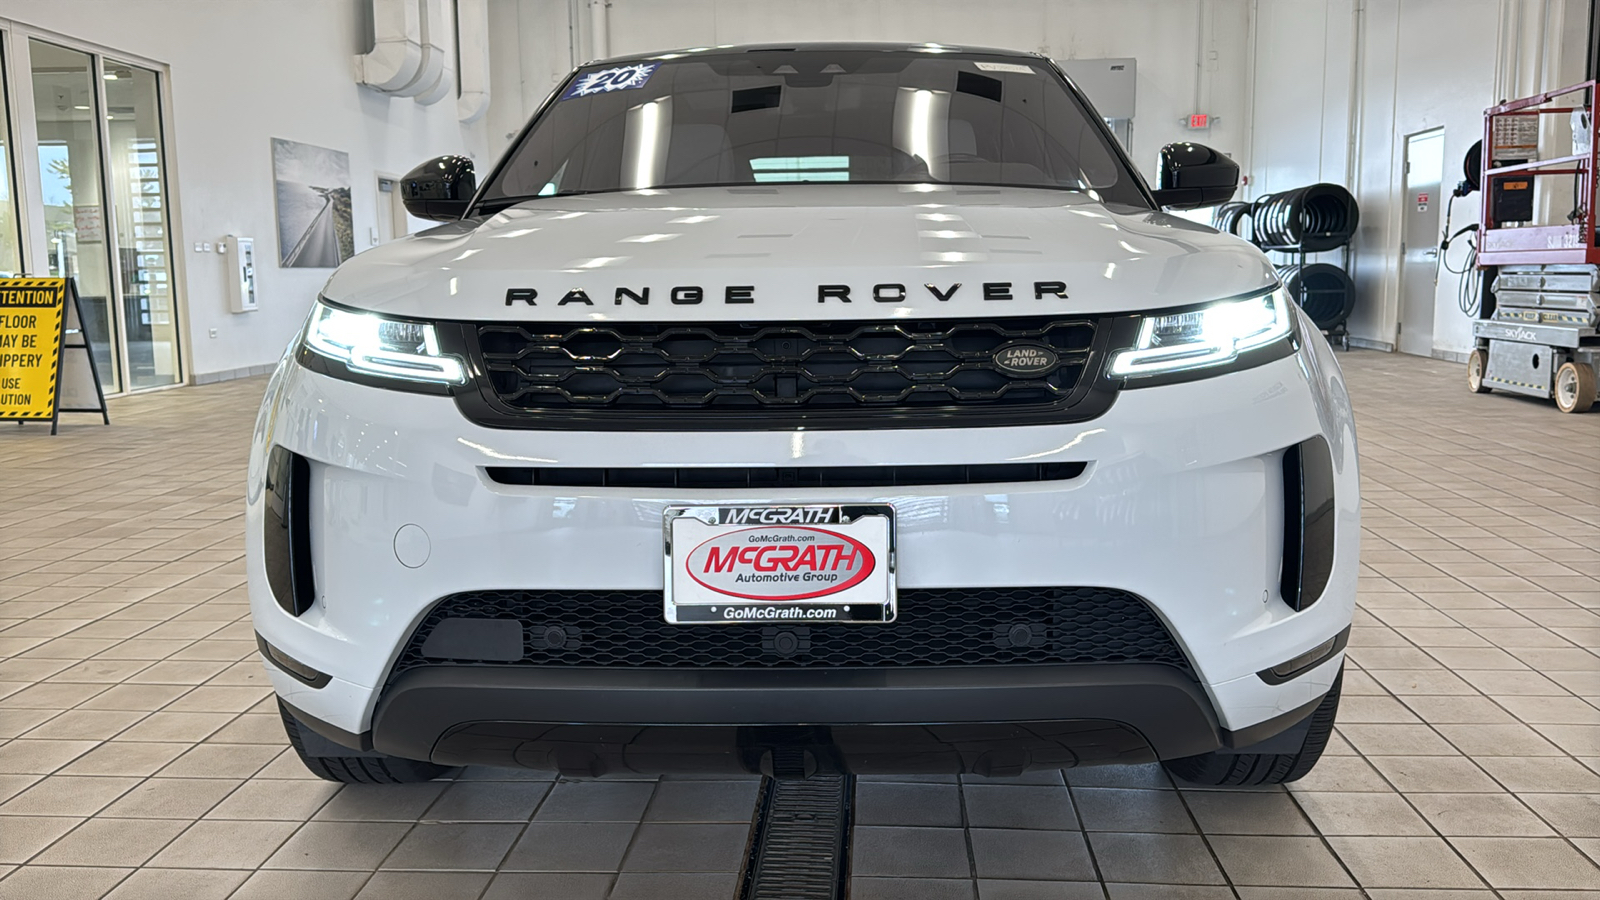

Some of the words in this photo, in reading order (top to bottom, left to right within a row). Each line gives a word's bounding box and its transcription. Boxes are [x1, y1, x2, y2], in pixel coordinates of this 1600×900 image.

[587, 69, 637, 90] 20
[0, 290, 53, 305] TENTION
[504, 285, 756, 306] RANGE
[817, 281, 1069, 303] ROVER
[0, 334, 18, 348] AY
[21, 334, 37, 348] BE
[1505, 327, 1537, 341] SKYJACK
[1010, 357, 1048, 367] ROVER
[1, 377, 21, 389] USE
[748, 533, 816, 544] GoMcGrath.com
[735, 573, 800, 583] Automotive
[802, 572, 838, 583] Group
[723, 606, 837, 620] GoMcGrath.com
